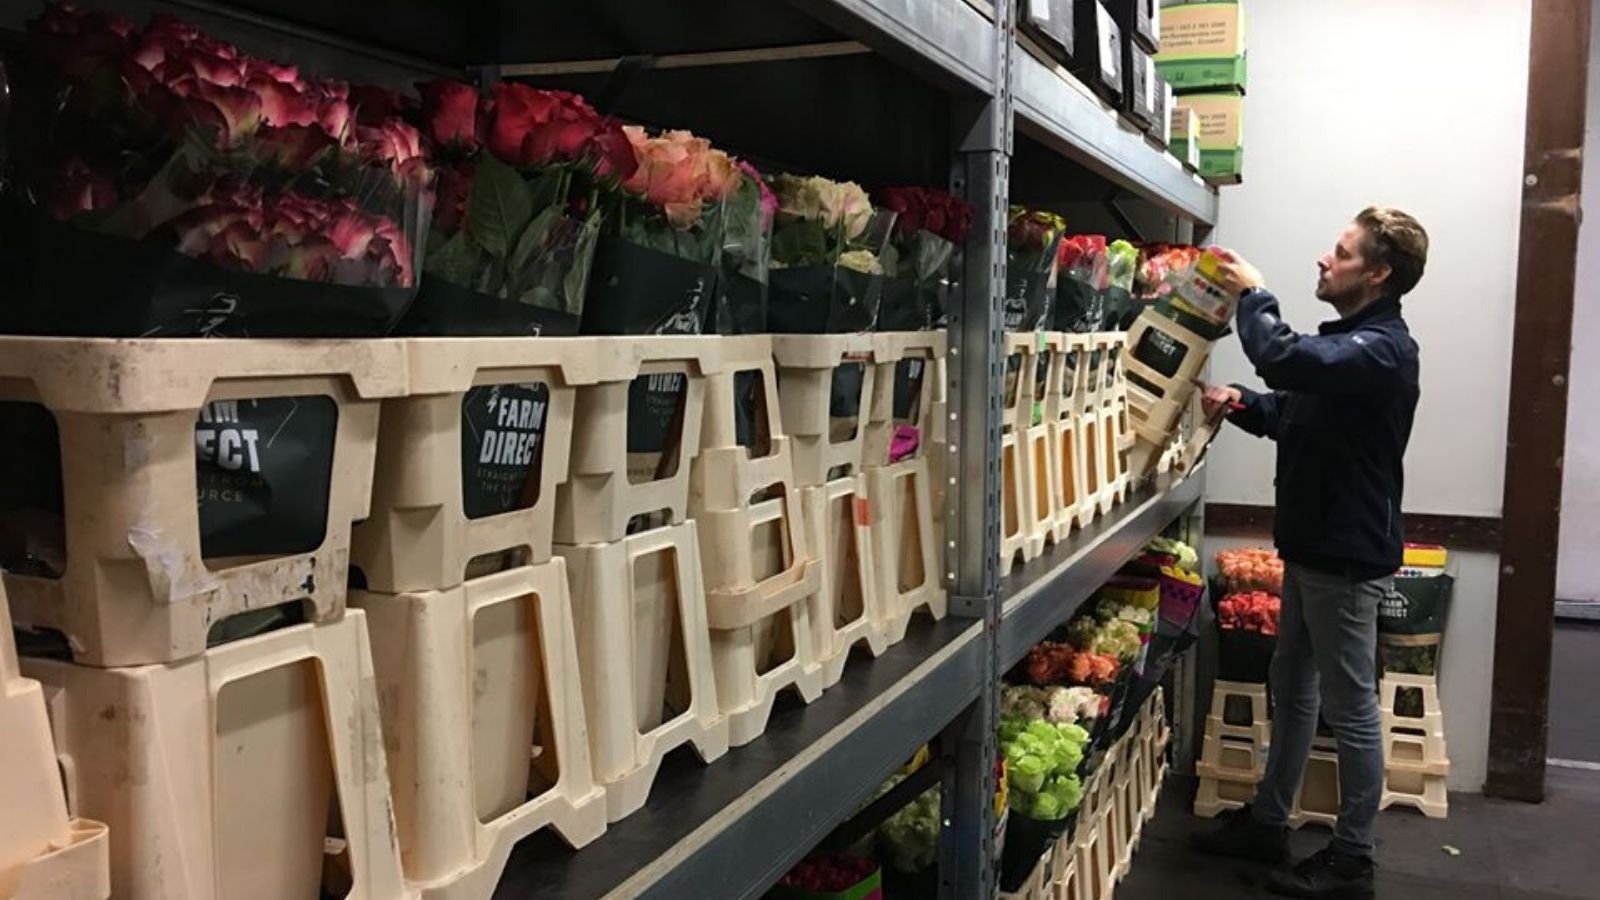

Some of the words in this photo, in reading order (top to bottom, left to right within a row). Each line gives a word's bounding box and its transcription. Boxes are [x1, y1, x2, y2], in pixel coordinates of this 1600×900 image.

[498, 397, 545, 430] FARM
[196, 429, 260, 472] ECT
[197, 488, 243, 502] URCE
